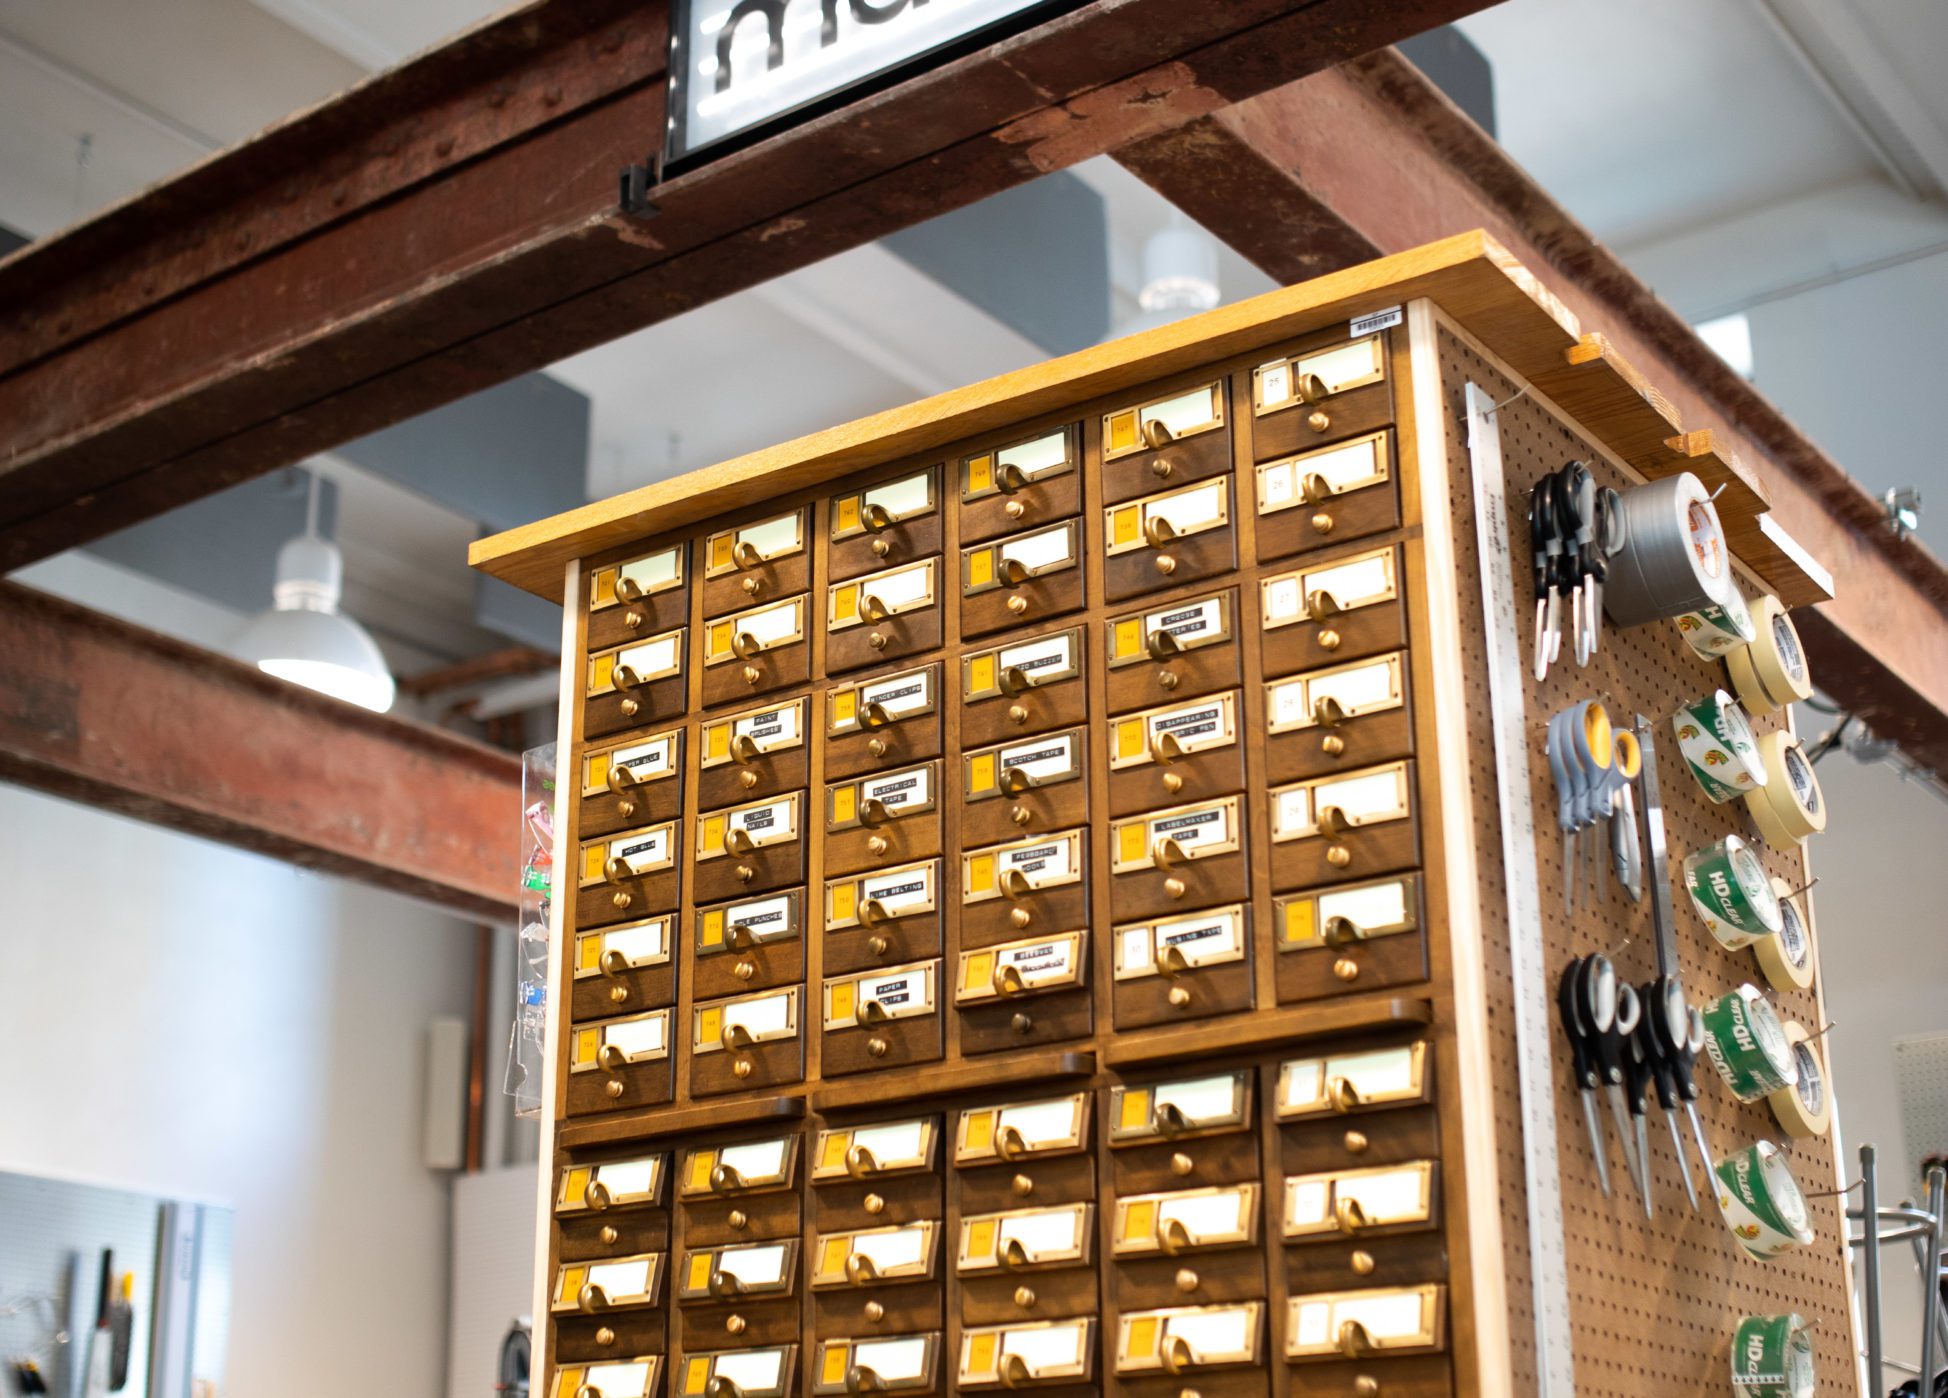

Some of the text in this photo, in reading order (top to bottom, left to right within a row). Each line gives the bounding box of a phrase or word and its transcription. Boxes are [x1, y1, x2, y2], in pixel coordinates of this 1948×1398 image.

[870, 686, 921, 702] BINDER CLIPS
[755, 714, 776, 723] PAINT
[1156, 712, 1216, 729] DISAPPEARING
[642, 754, 658, 764] GLUE
[1009, 749, 1059, 765] SCOTCH TAPE
[874, 780, 916, 794] ELECTRICAL
[884, 795, 902, 803] TAPE
[746, 821, 768, 829] NAILS
[1160, 815, 1212, 830] LABELMAKER
[1173, 831, 1193, 839] TAPE
[624, 842, 655, 854] HOT GLUE
[1016, 848, 1055, 860] PEGBOARD
[1709, 871, 1730, 897] HD
[1720, 897, 1744, 925] CLEAR
[753, 913, 782, 922] PUNCHES
[1201, 928, 1222, 936] TAPE
[879, 983, 901, 993] PAPER
[880, 996, 902, 1004] CLIPS
[1730, 999, 1756, 1051] HD CLEAR
[1704, 1030, 1738, 1085] HD CLEAR
[1737, 1173, 1756, 1204] CLEAR
[1747, 1334, 1764, 1361] HD
